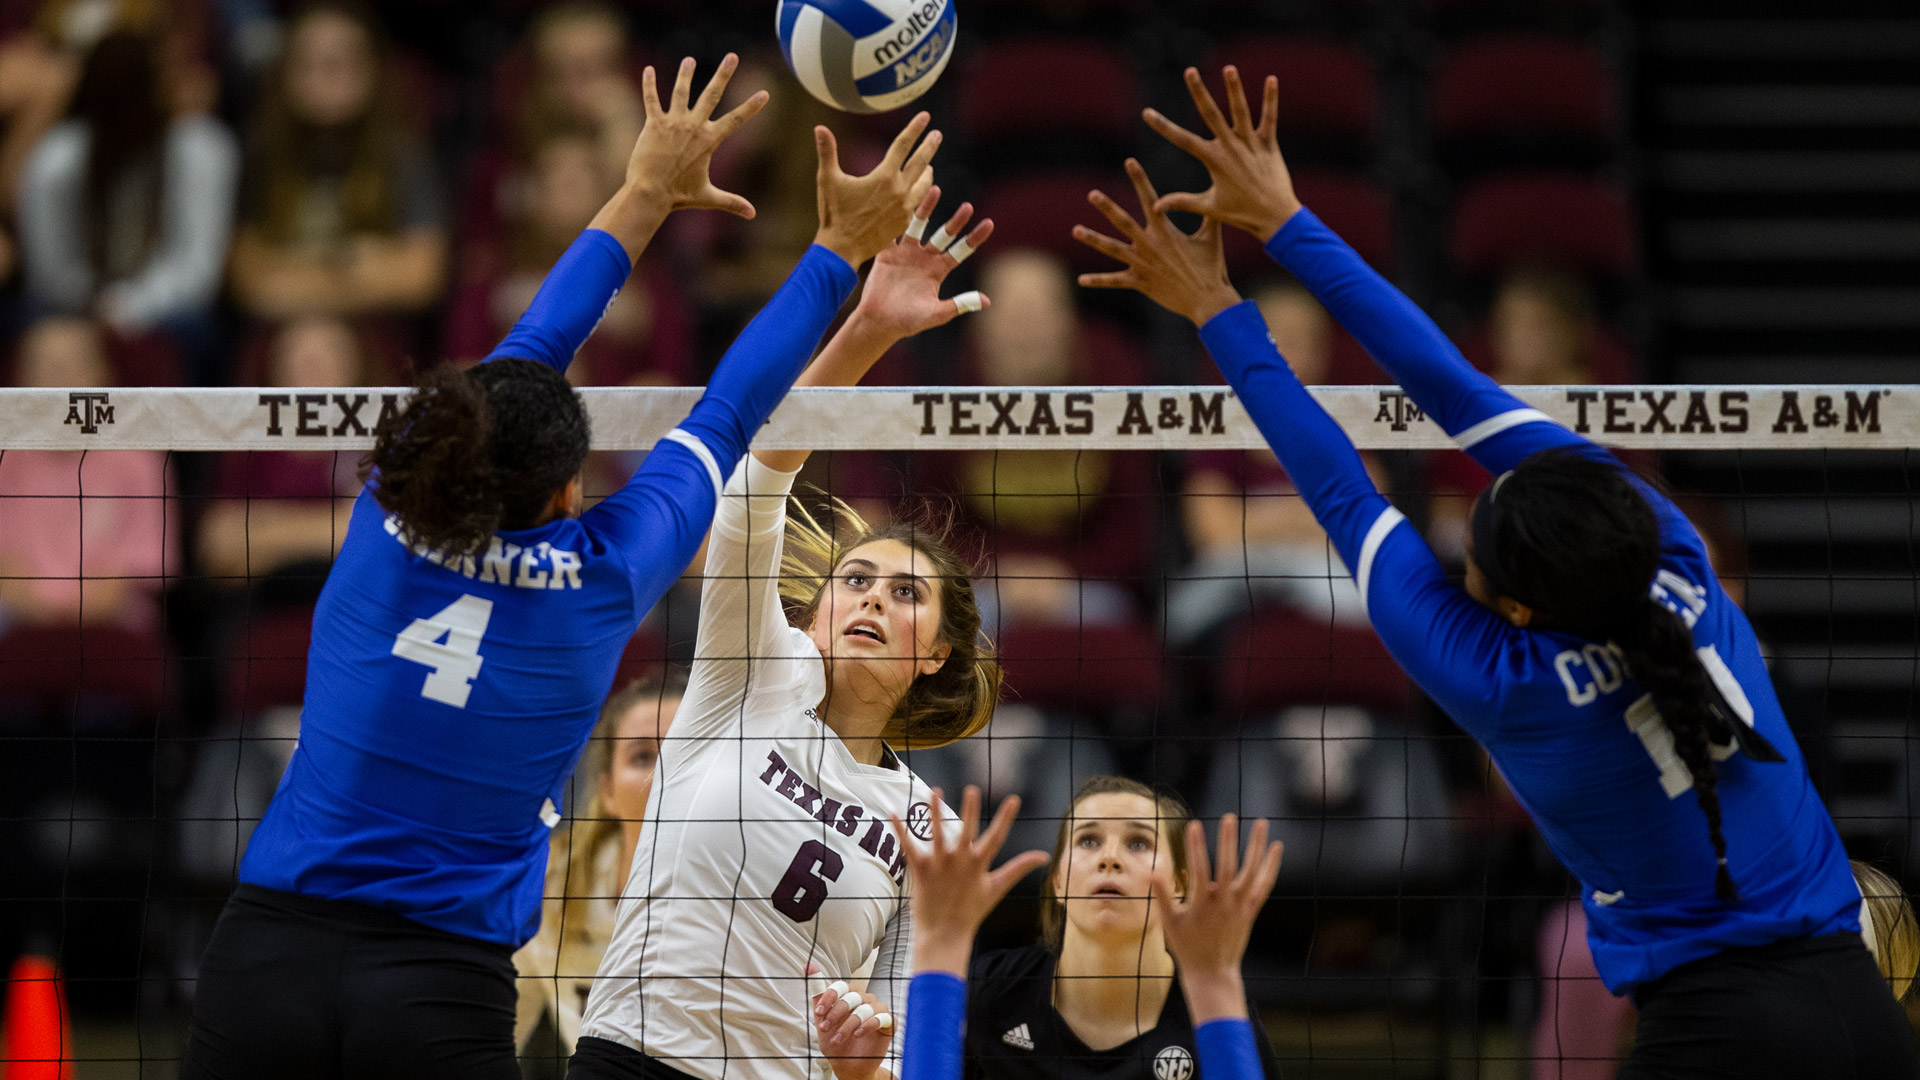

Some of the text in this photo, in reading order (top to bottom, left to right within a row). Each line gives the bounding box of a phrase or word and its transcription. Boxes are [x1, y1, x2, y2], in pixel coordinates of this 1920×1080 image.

[259, 393, 400, 436] TEXA
[913, 392, 1227, 435] TEXAS A&M
[1566, 391, 1882, 433] TEXAS A&M
[391, 593, 494, 709] 4
[759, 749, 864, 837] TEXAS
[771, 839, 844, 923] 6
[1002, 1034, 1035, 1050] adidas
[1156, 1048, 1191, 1080] SEC
